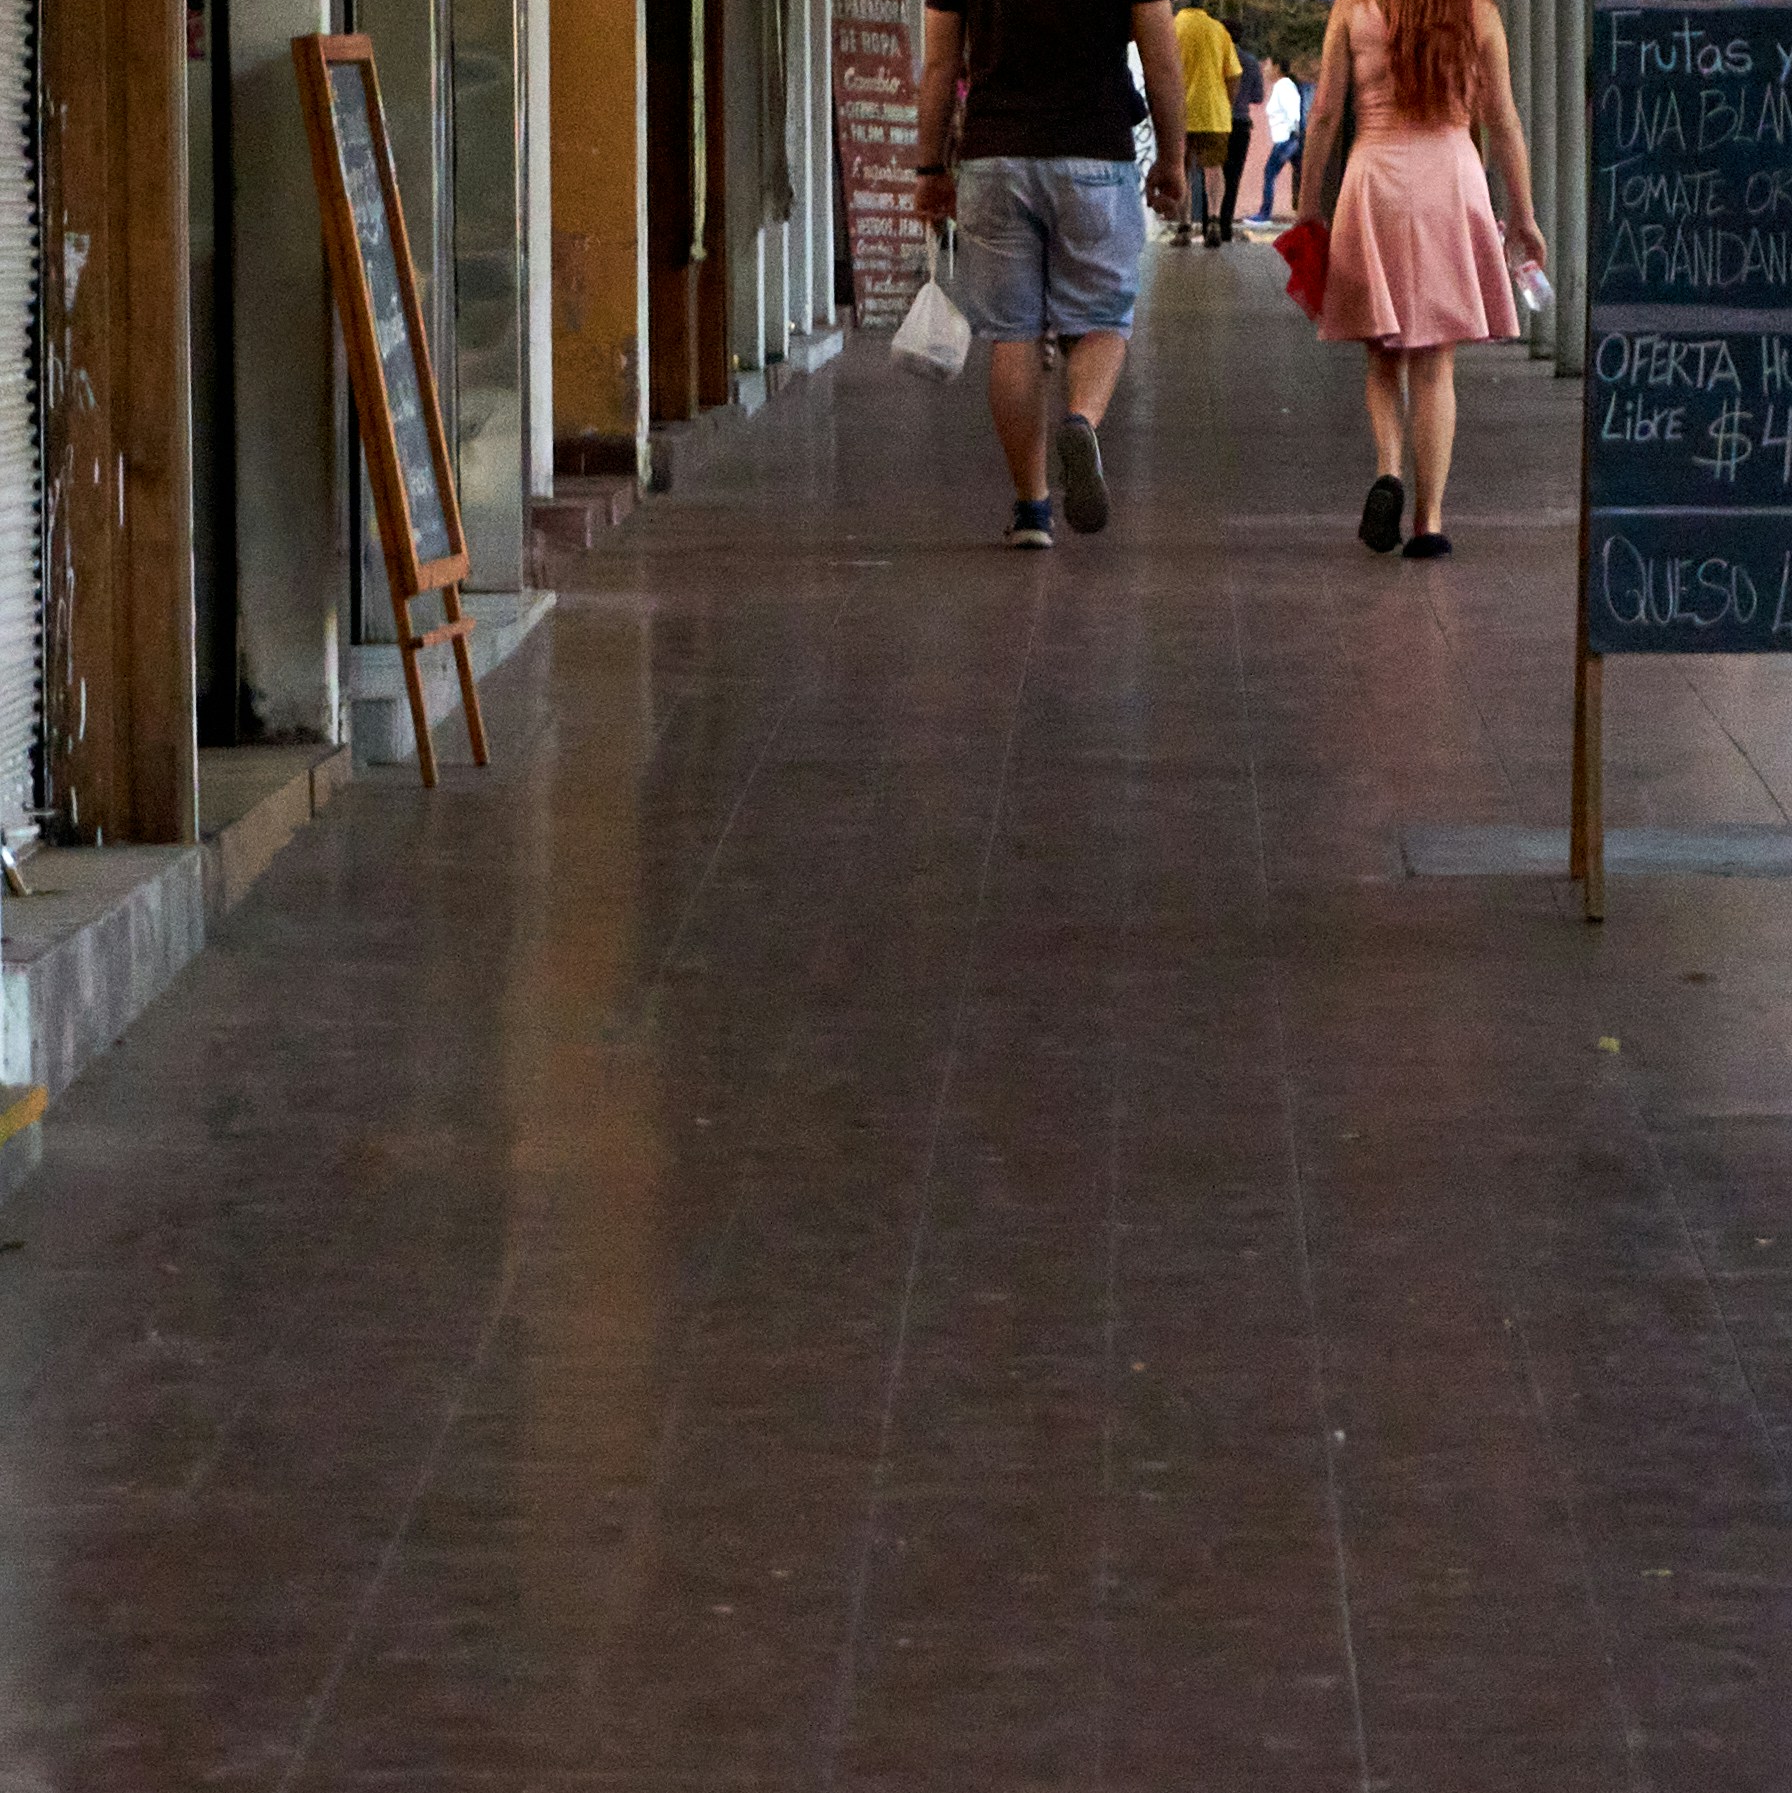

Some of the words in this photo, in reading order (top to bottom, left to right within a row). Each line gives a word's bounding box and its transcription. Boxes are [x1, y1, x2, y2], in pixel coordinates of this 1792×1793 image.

[1611, 11, 1754, 74] Frutas
[1600, 84, 1687, 152] UVA
[1597, 332, 1742, 392] OFERTA
[1602, 533, 1759, 627] QUESO
